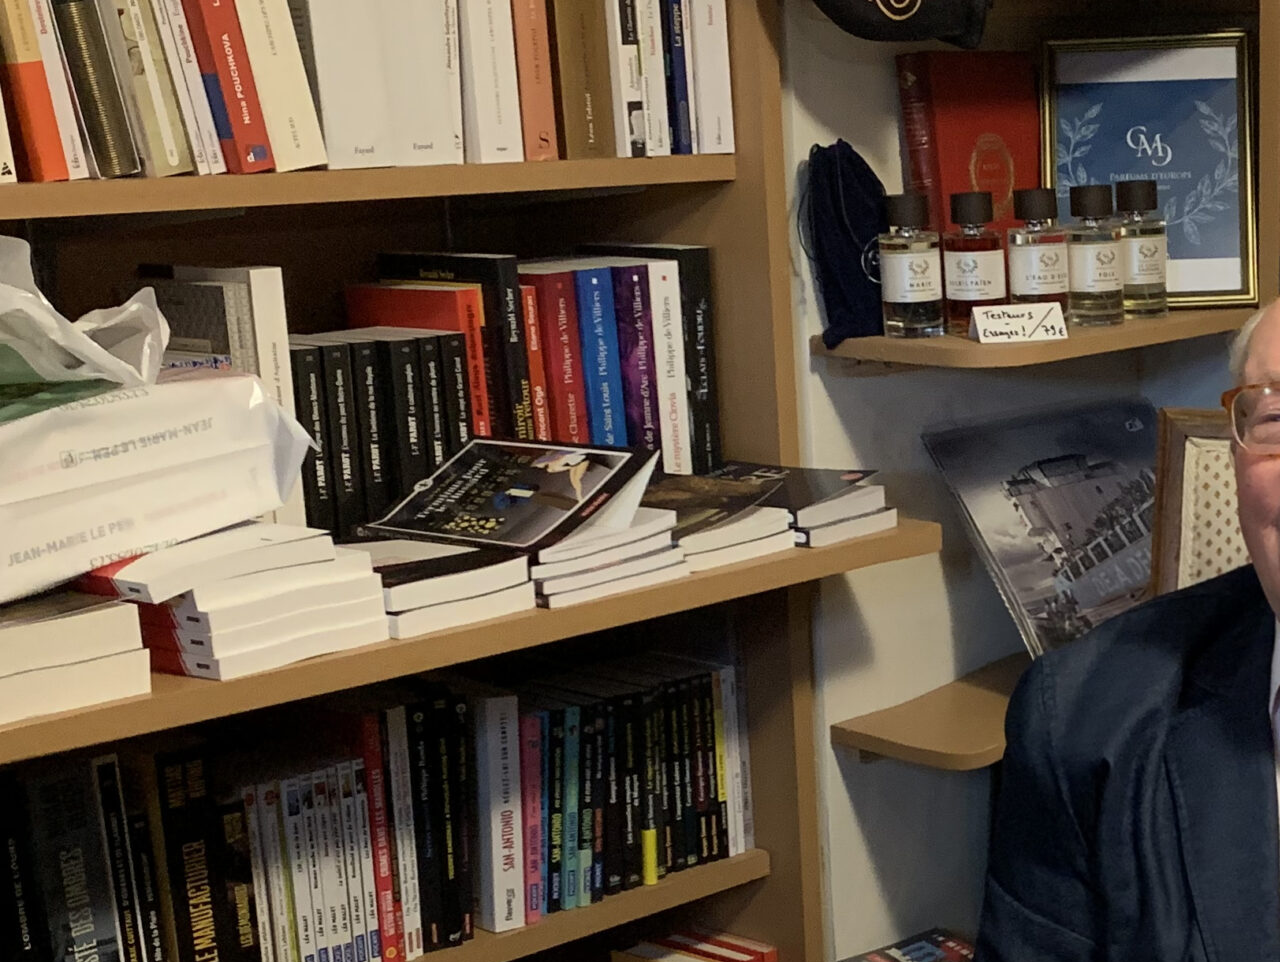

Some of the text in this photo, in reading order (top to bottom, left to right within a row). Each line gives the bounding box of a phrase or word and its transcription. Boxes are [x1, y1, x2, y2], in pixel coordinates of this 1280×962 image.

[222, 32, 252, 124] Nina POUCHKOVA
[406, 415, 419, 442] PAROT
[121, 442, 137, 455] LE
[370, 443, 381, 469] PAROT
[315, 459, 326, 486] PAROT
[340, 452, 352, 479] PAROT
[8, 531, 88, 567] JEAN-MARIE
[90, 526, 106, 540] LE
[500, 810, 514, 871] SAN-ANTONIO
[60, 848, 90, 906] OMBRES
[178, 840, 220, 950] MANUFACTURIER
[68, 906, 95, 935] DES
